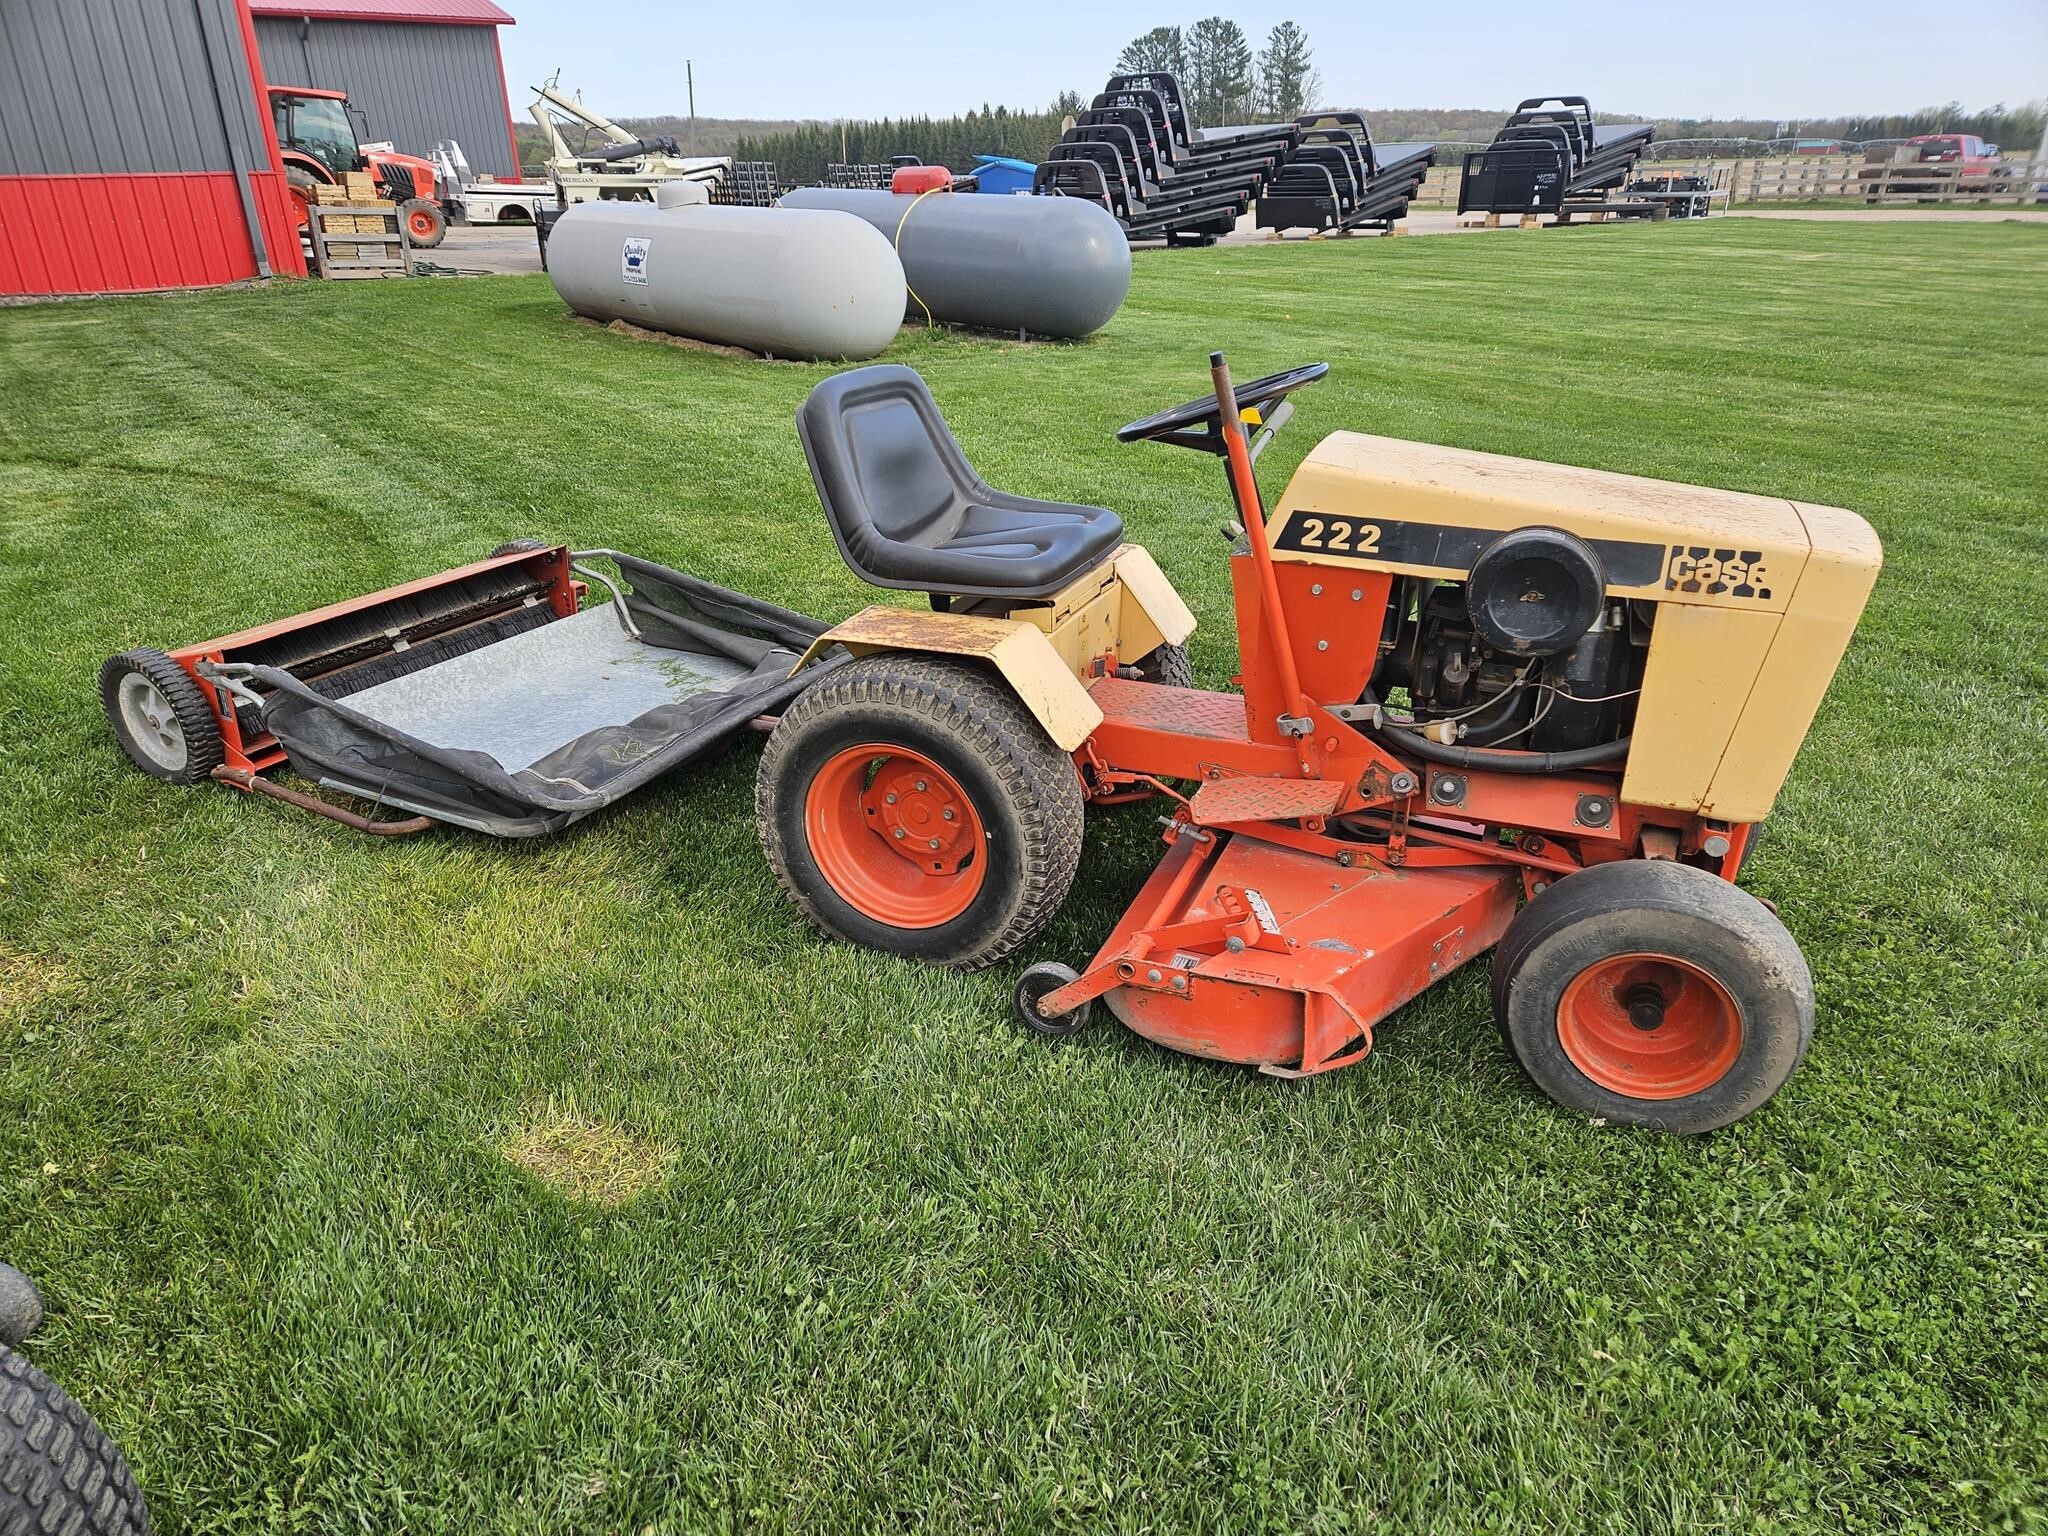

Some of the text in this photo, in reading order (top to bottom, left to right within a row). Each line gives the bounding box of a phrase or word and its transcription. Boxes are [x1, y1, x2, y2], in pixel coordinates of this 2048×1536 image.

[562, 176, 593, 184] MERIDIAN
[624, 244, 647, 262] Quality
[1300, 518, 1382, 554] 222
